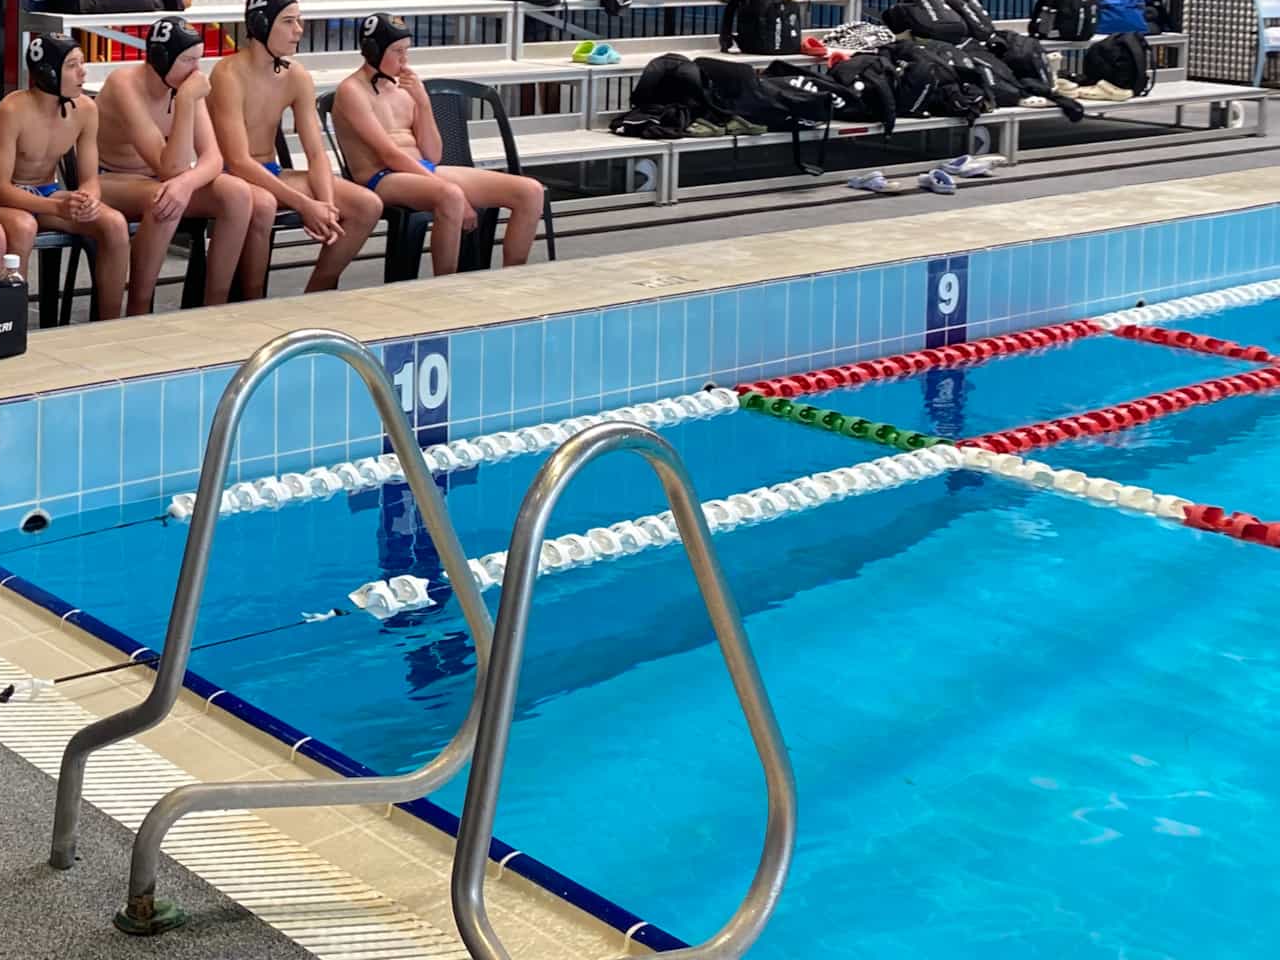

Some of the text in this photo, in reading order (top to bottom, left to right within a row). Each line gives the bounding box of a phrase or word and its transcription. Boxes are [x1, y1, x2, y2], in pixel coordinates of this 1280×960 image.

[150, 21, 173, 43] 13
[363, 15, 379, 36] 9
[937, 272, 960, 315] 9
[393, 352, 448, 412] 10
